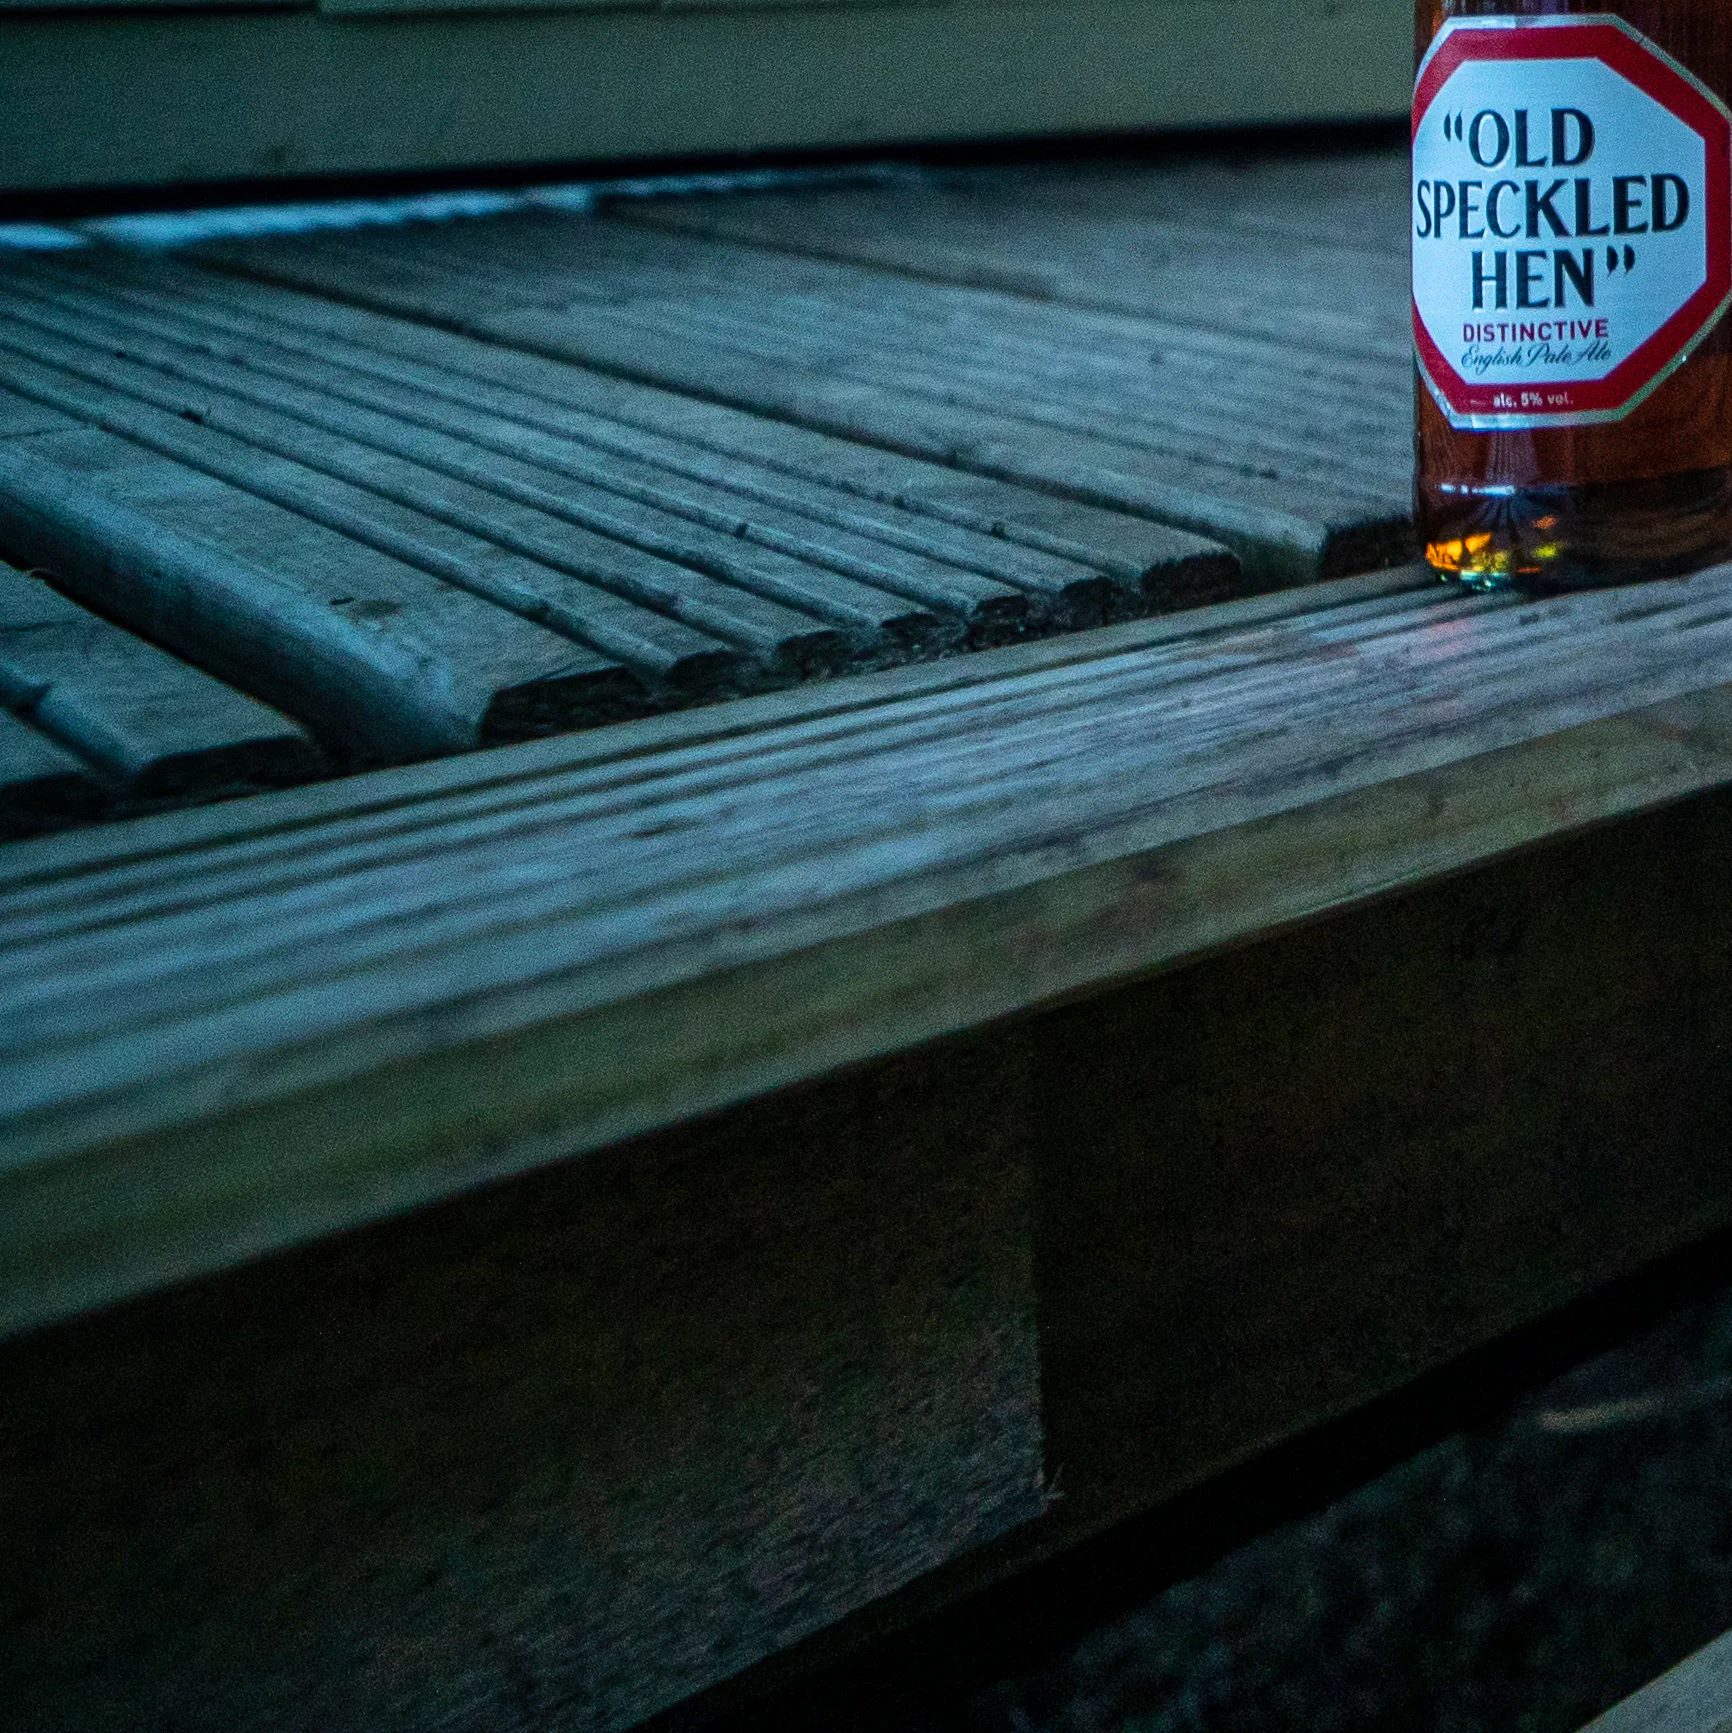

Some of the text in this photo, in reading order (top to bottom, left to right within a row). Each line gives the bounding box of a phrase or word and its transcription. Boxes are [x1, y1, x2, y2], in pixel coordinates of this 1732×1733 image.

[1443, 108, 1596, 169] “OLD
[1416, 172, 1690, 240] SPECKLED
[1471, 243, 1636, 311] HEN”
[1463, 319, 1609, 343] DISTINCTIVE
[1461, 339, 1612, 375] English Pale Ale
[1493, 391, 1574, 408] alc. 5% vol.
